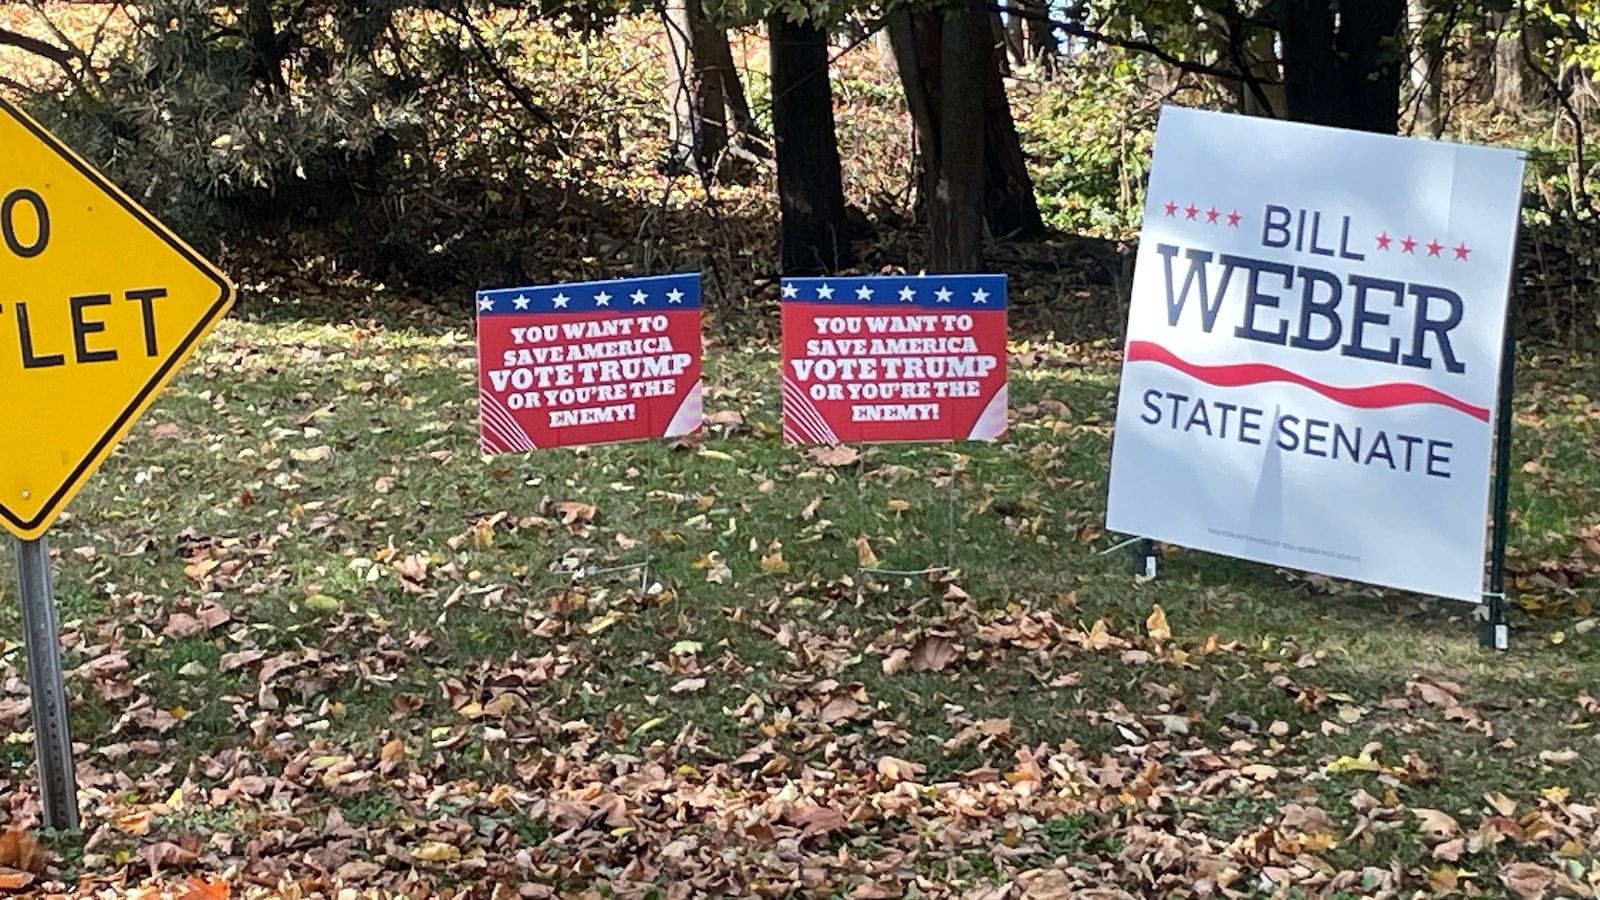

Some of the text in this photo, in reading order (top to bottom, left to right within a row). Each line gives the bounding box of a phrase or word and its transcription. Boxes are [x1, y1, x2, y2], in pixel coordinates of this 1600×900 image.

[1261, 204, 1366, 261] BILL
[1156, 243, 1466, 374] WEBER
[510, 315, 668, 344] YOU WANT TO
[813, 313, 973, 334] YOU WANT TO
[503, 336, 674, 367] SAVE AMERICA
[806, 336, 978, 356] SAVE AMERICA
[488, 353, 692, 392] VOTE TRUMP
[790, 355, 997, 381] VOTE TRUMP
[507, 379, 676, 410] OR YOU'RE THE
[809, 380, 981, 401] OR YOU'RE THE
[548, 404, 636, 428] ENEMY!
[851, 403, 940, 422] ENEMY!
[1140, 388, 1453, 479] STATE SENATE
